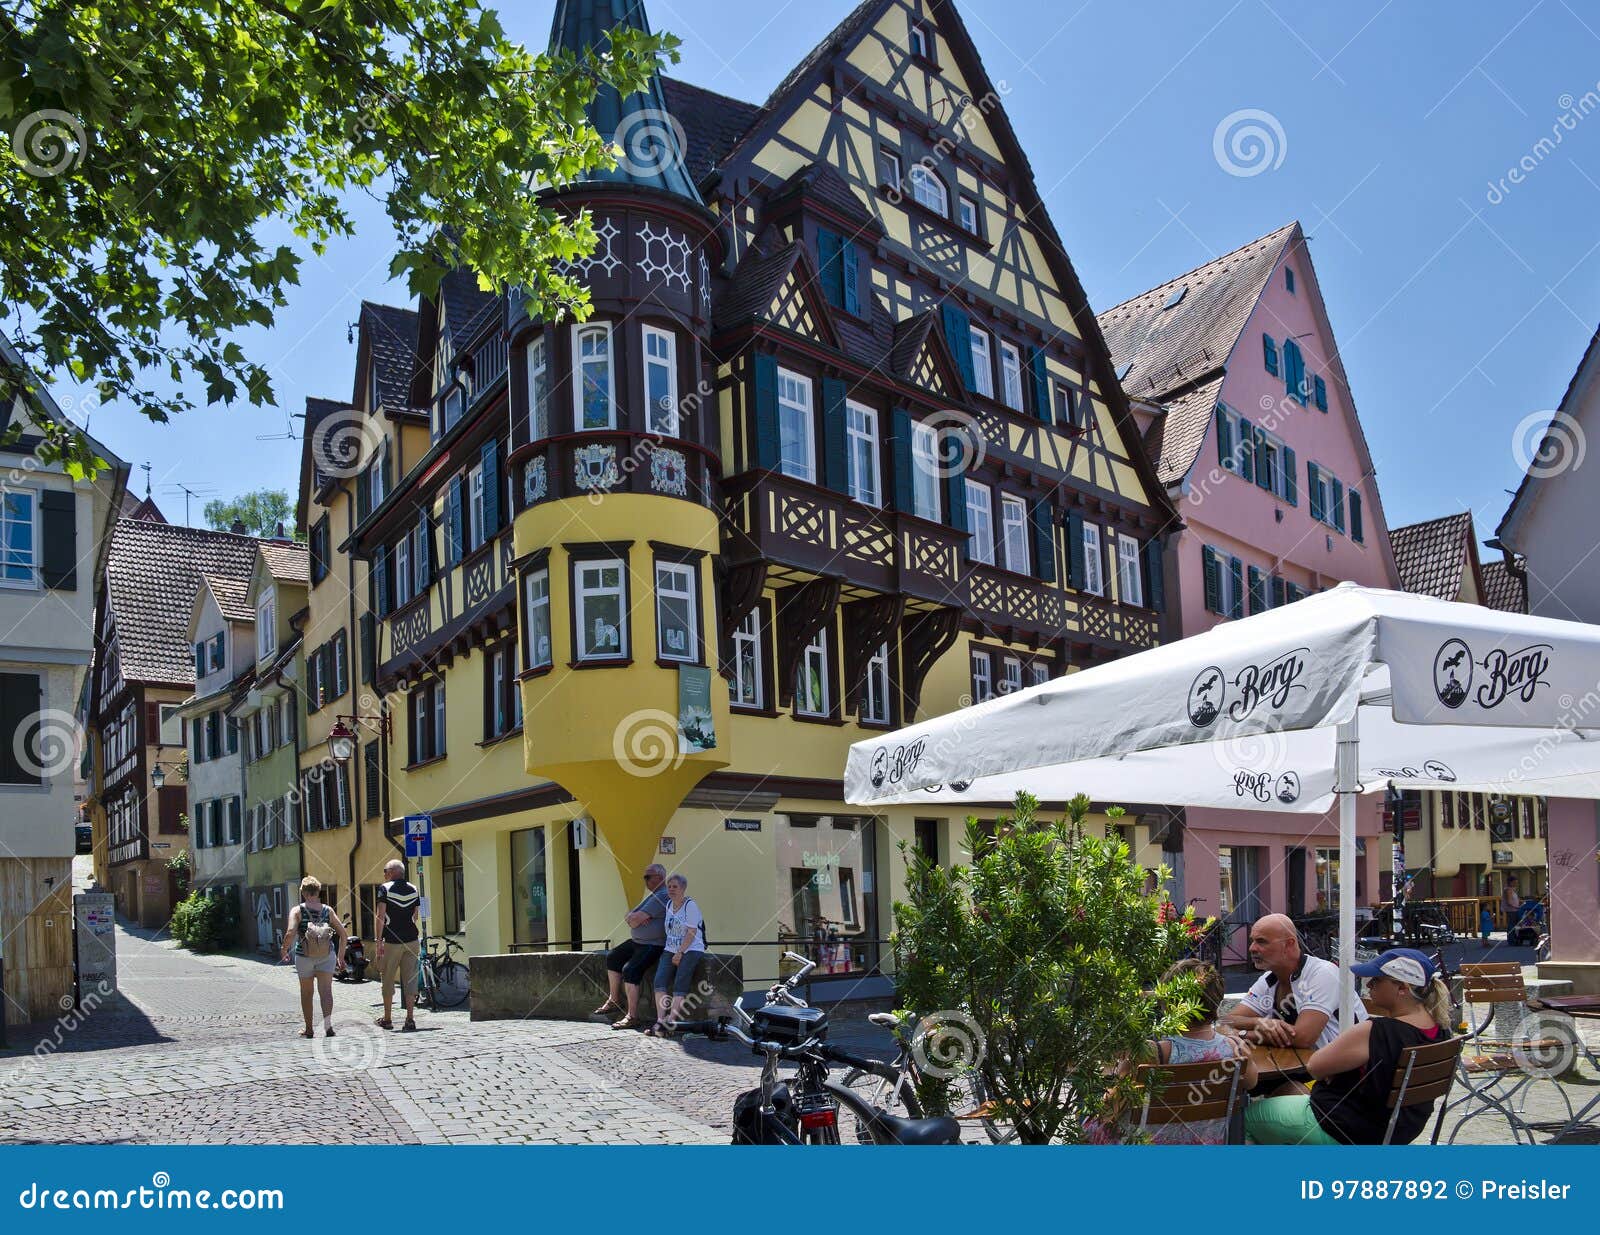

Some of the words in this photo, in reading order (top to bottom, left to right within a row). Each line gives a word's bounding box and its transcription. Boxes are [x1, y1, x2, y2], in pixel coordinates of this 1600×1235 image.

[1228, 648, 1310, 722] Berg
[1477, 644, 1553, 709] Berg
[889, 735, 929, 783] Berg
[812, 873, 832, 885] GEA
